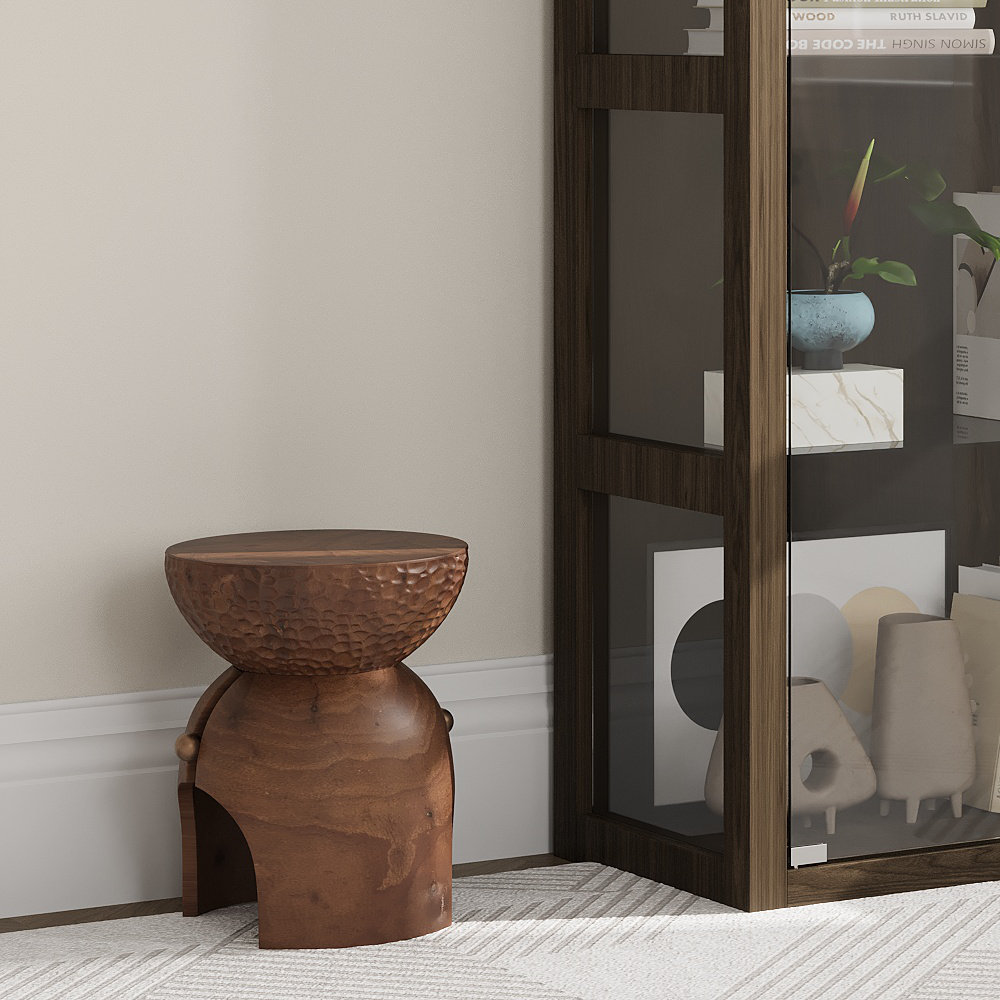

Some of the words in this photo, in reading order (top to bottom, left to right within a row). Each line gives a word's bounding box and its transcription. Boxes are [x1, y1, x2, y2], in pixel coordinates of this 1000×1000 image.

[792, 12, 835, 21] WOOD
[890, 12, 921, 21] RUTH
[926, 12, 967, 21] SLAVID
[812, 39, 854, 50] CODE
[857, 39, 887, 50] THE
[892, 39, 936, 49] SINGH
[940, 39, 986, 49] SIMON
